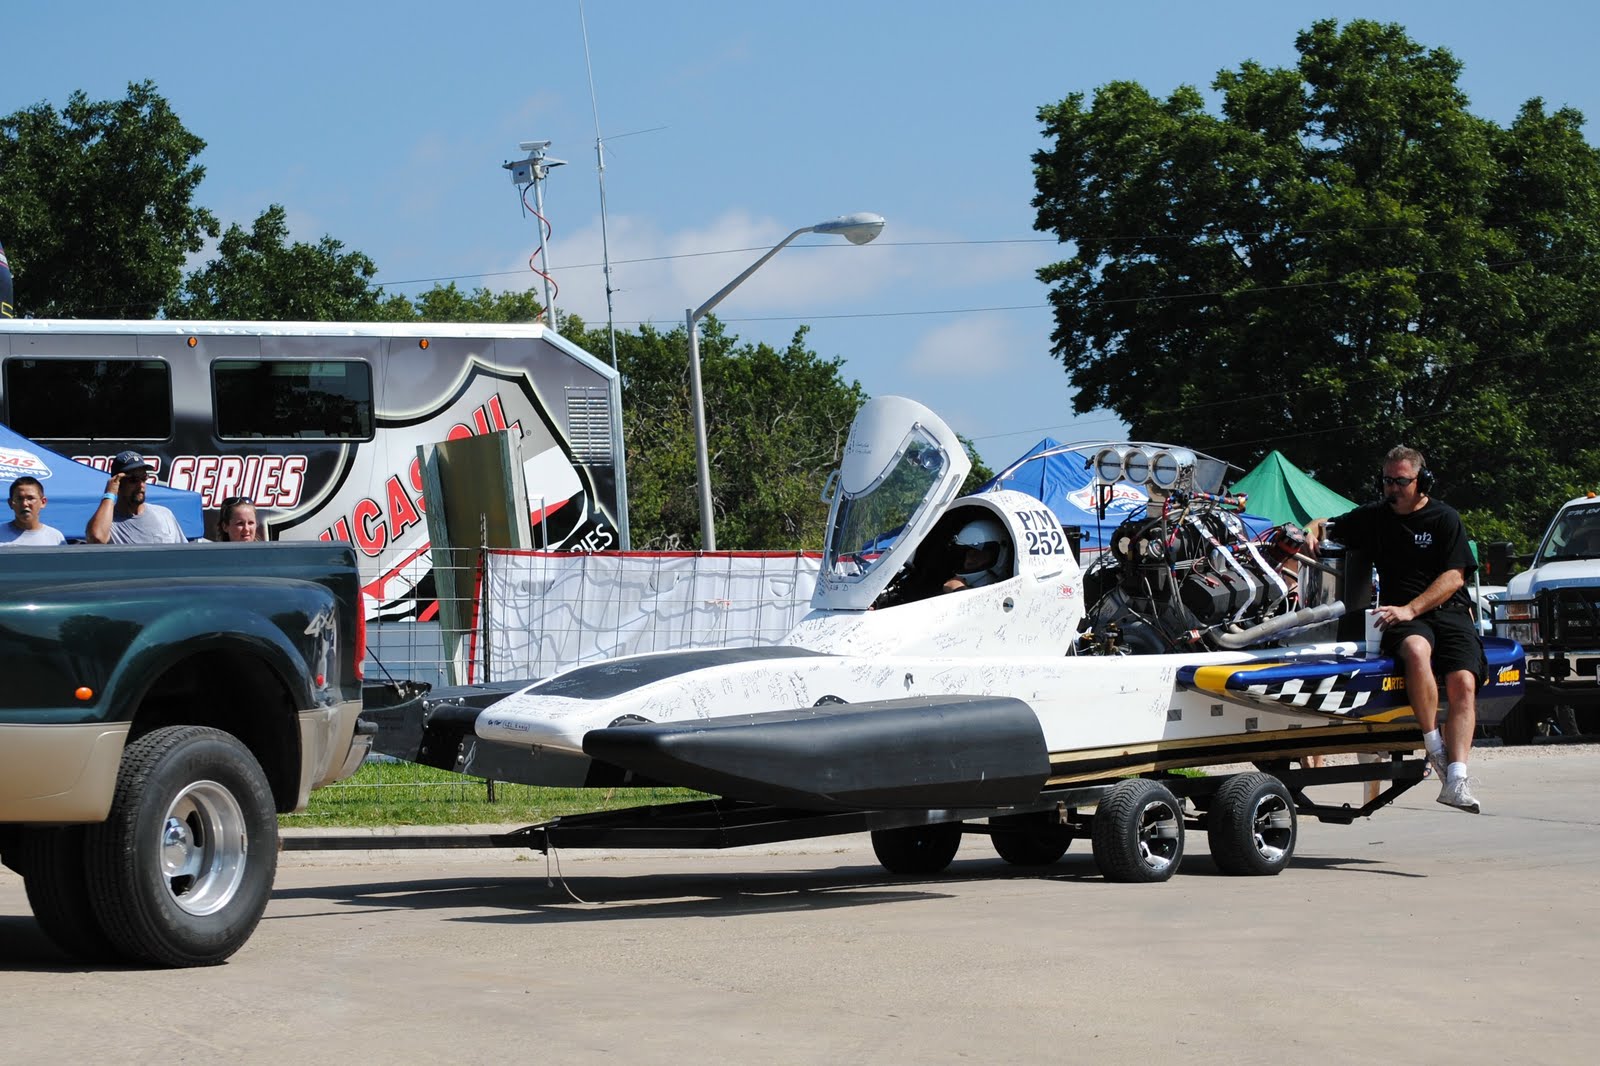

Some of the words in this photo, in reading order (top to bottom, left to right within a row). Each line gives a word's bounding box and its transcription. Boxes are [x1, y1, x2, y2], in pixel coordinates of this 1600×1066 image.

[0, 454, 36, 467] CAS
[169, 456, 307, 508] SERIES
[1089, 489, 1140, 507] LUCAS
[1014, 509, 1058, 531] P/M
[1025, 530, 1065, 555] 252
[1381, 676, 1406, 692] CARTE
[1498, 669, 1521, 683] SIGNS
